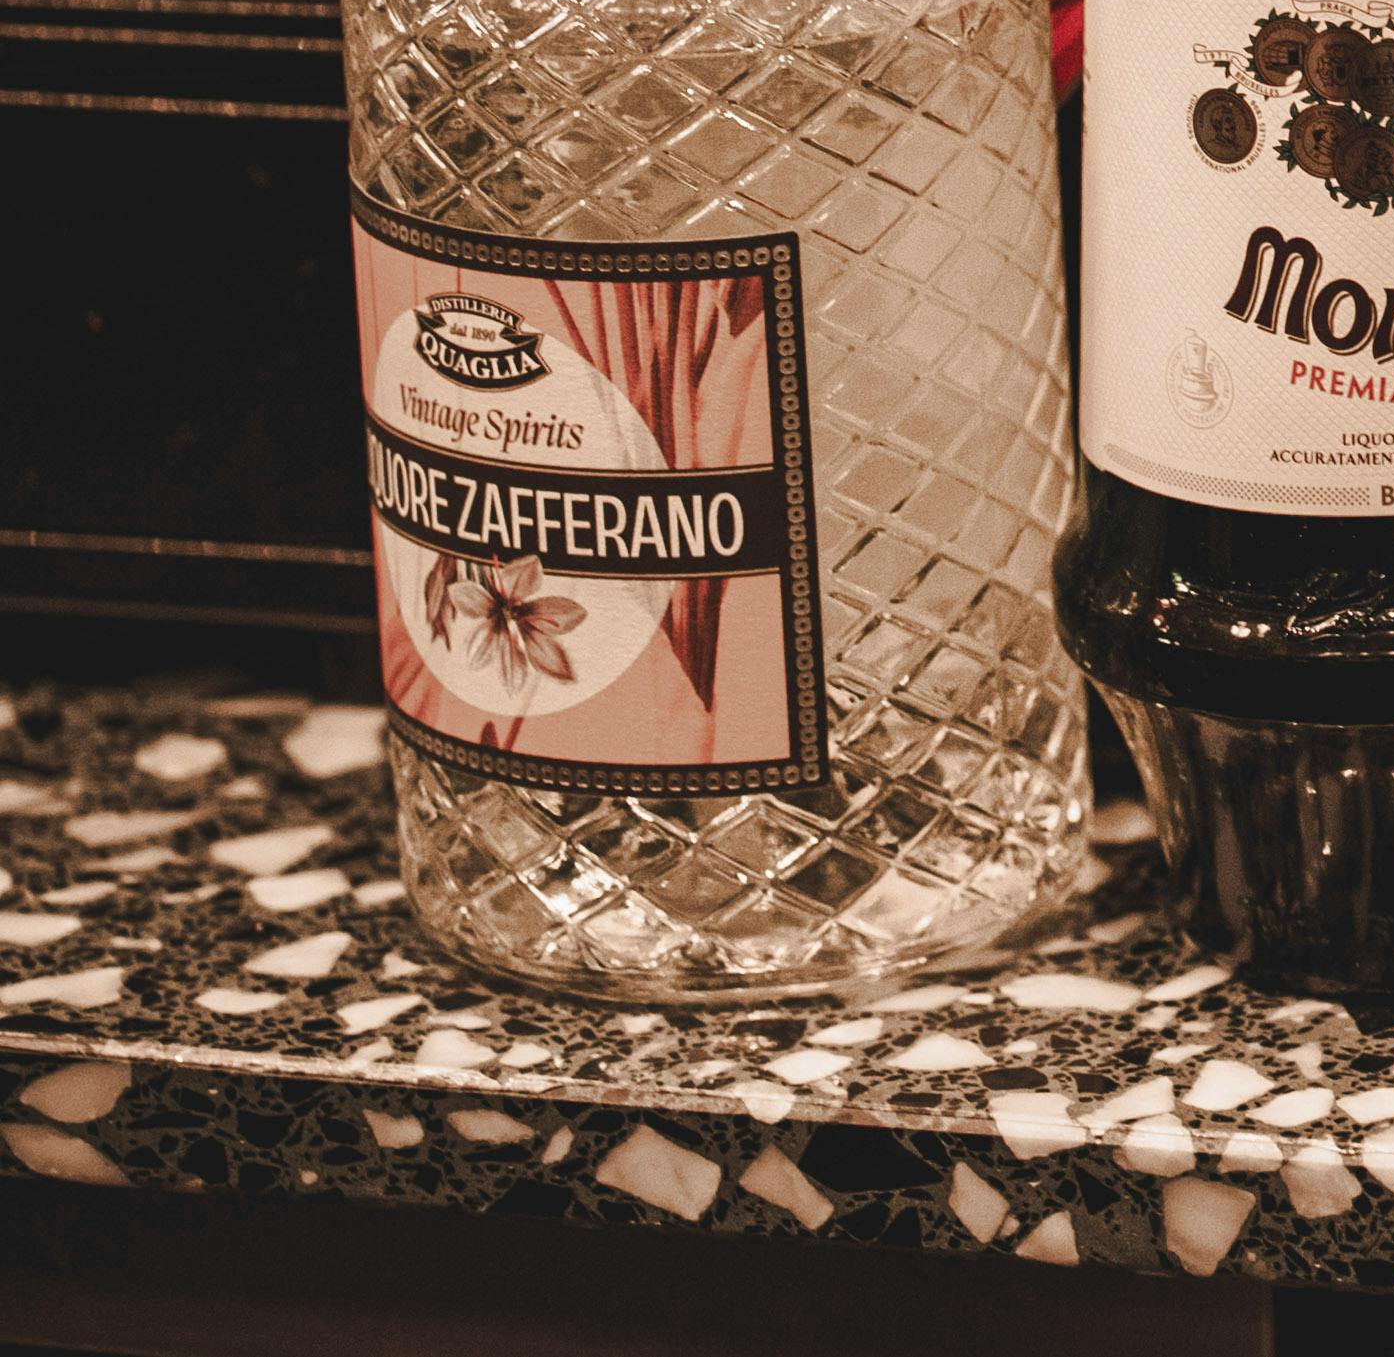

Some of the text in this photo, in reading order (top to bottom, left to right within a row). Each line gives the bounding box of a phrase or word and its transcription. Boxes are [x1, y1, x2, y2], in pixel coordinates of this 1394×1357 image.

[1319, 2, 1354, 16] PRAGA
[431, 297, 516, 327] DISTILLERIA
[450, 323, 496, 342] dal 1890
[421, 331, 541, 380] QUAGLIA
[400, 383, 585, 454] Vintage Spirits
[454, 475, 744, 558] ZAFFERANO
